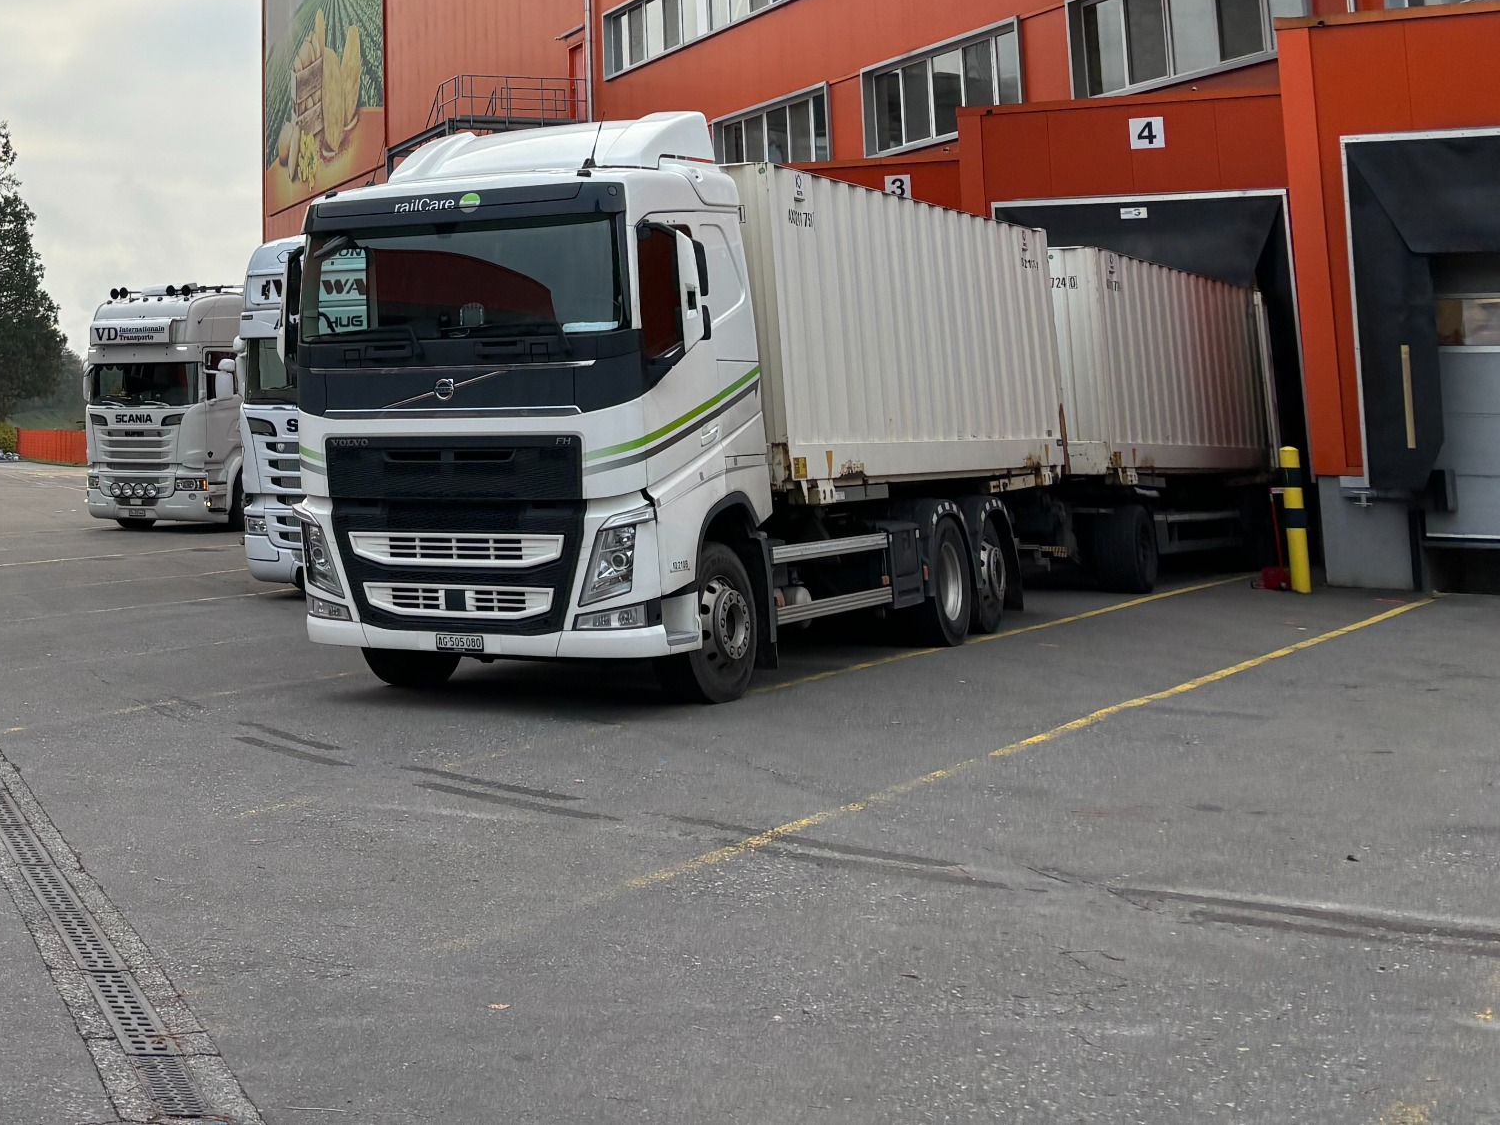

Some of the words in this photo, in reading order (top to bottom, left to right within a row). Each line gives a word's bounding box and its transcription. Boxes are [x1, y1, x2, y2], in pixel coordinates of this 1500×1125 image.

[1137, 121, 1157, 145] 4
[890, 178, 906, 197] 3
[394, 198, 455, 214] railCare
[94, 327, 118, 341] VD
[115, 413, 153, 423] SCANIA
[330, 438, 369, 446] VOLVO
[555, 437, 571, 445] FH
